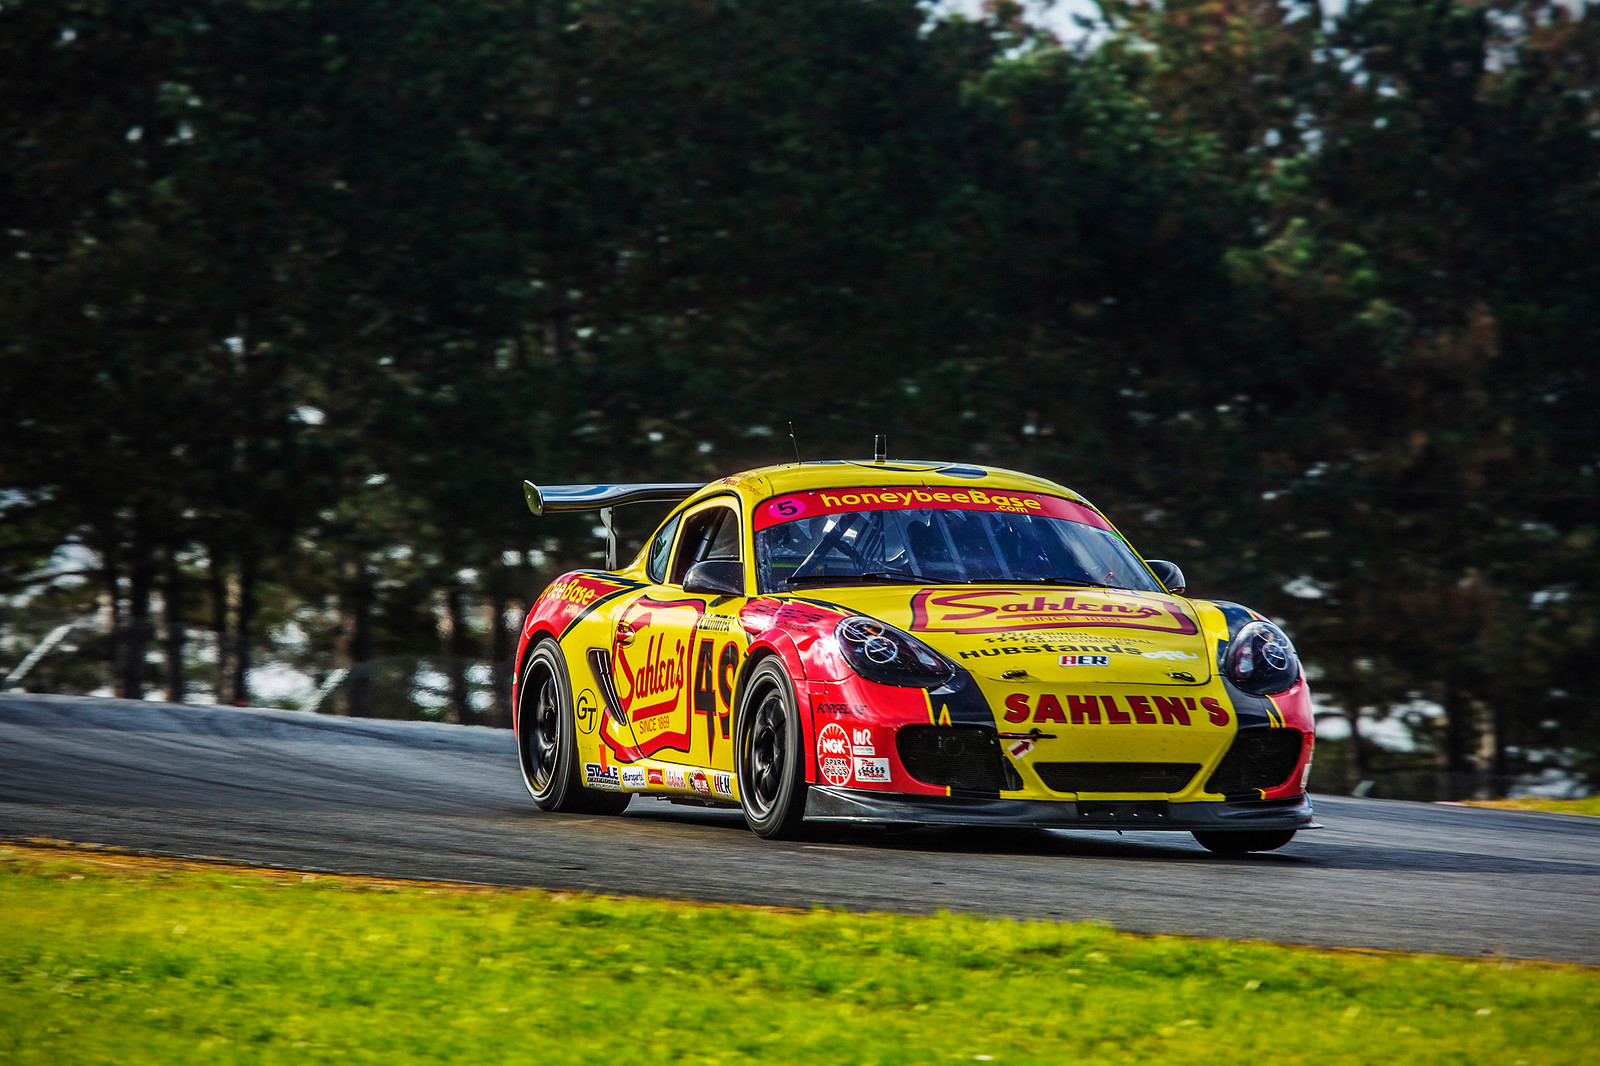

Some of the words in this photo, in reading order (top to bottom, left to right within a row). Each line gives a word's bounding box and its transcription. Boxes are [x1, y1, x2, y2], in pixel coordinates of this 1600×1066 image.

[778, 501, 798, 516] 5
[820, 490, 1041, 511] honeybeeBase
[931, 592, 1162, 620] Sahlen's
[1022, 615, 1072, 623] SINCE
[958, 643, 1142, 660] HUBstands
[617, 612, 685, 711] Sahlen's
[577, 696, 596, 731] GT
[1003, 693, 1230, 727] SAHLEN'S
[639, 718, 657, 735] SINCE
[822, 739, 846, 754] NGK
[825, 758, 847, 767] SPARK
[826, 767, 848, 776] PLUGS
